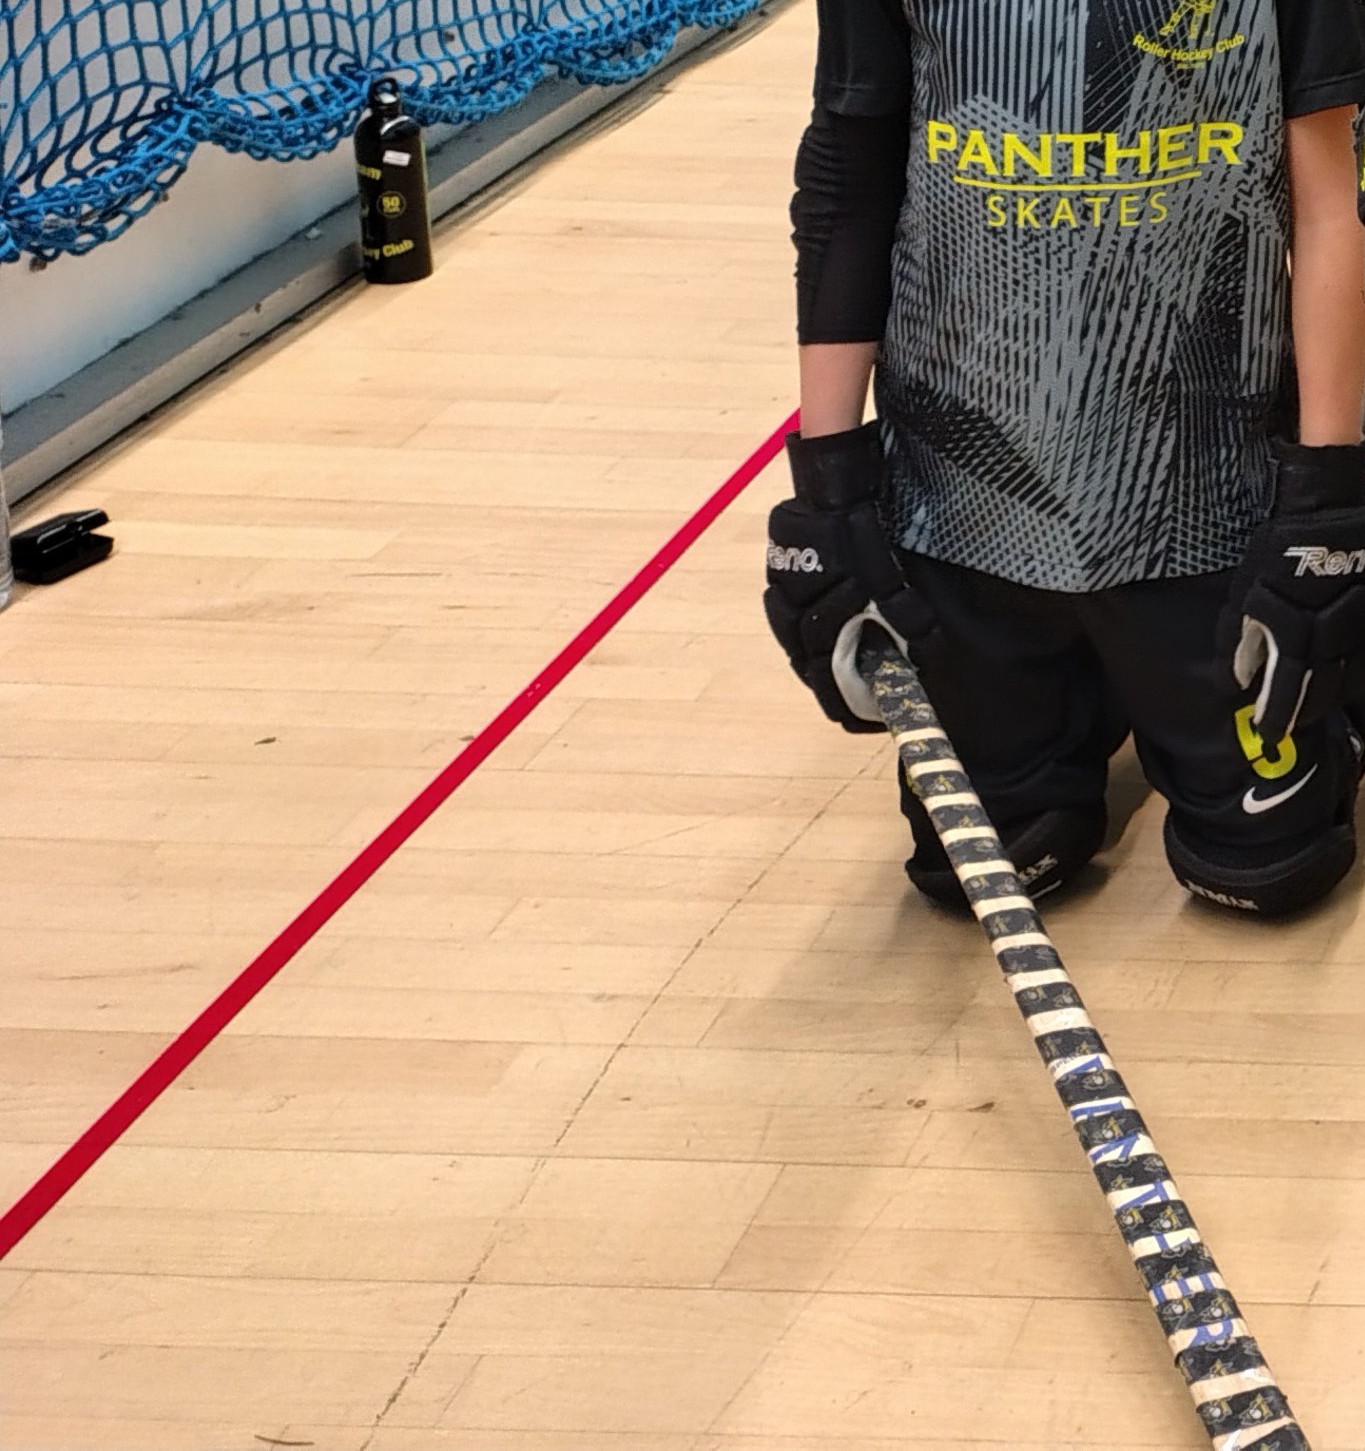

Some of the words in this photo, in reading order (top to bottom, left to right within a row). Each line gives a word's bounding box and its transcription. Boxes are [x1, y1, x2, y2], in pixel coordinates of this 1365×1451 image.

[1132, 33, 1170, 58] Roller
[1170, 48, 1213, 62] Hockey
[1215, 32, 1246, 53] Club
[927, 120, 1245, 178] PANTHER
[986, 191, 1168, 230] SKATES
[382, 239, 414, 258] Club
